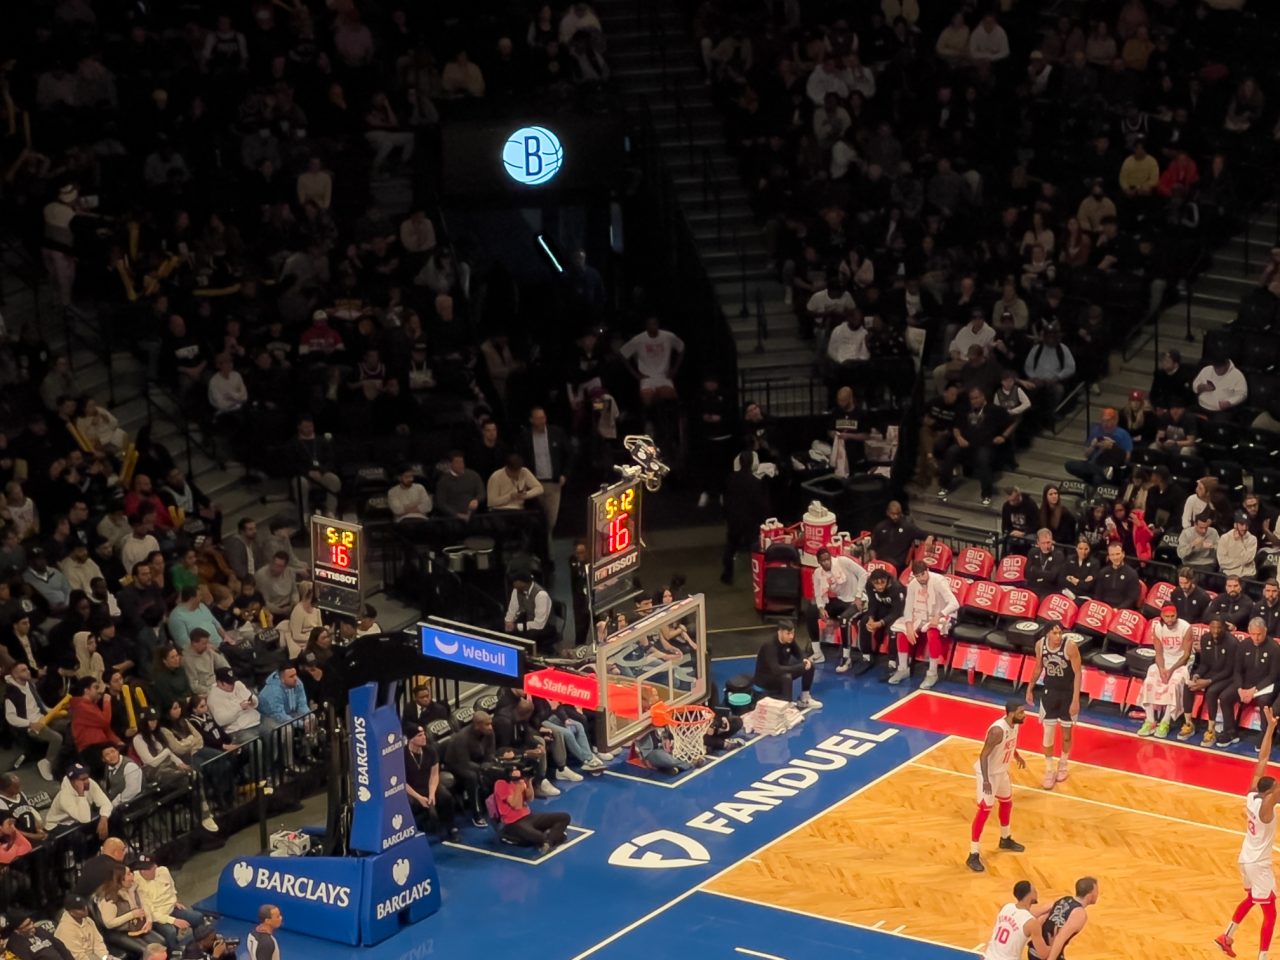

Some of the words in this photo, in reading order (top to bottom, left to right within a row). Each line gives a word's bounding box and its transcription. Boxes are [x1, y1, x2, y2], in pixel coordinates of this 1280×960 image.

[524, 136, 541, 177] B
[608, 512, 630, 551] 16
[331, 545, 348, 567] 16
[966, 549, 985, 561] BIO
[1002, 557, 1021, 567] BIO
[327, 571, 358, 585] TISSOT
[977, 583, 996, 595] BIO
[1009, 591, 1029, 601] BIO
[1051, 596, 1070, 610] BIO
[1089, 602, 1108, 616] BIO
[1120, 610, 1139, 625] BIO
[463, 643, 506, 667] Webull
[542, 678, 591, 701] StateFarm
[354, 716, 369, 785] BARCLAYS
[686, 728, 900, 834] FANDUEL
[382, 825, 416, 849] BARCLAYS
[255, 867, 351, 908] BARCLAYS
[376, 878, 432, 920] BARCLAYS
[994, 926, 1011, 944] 10
